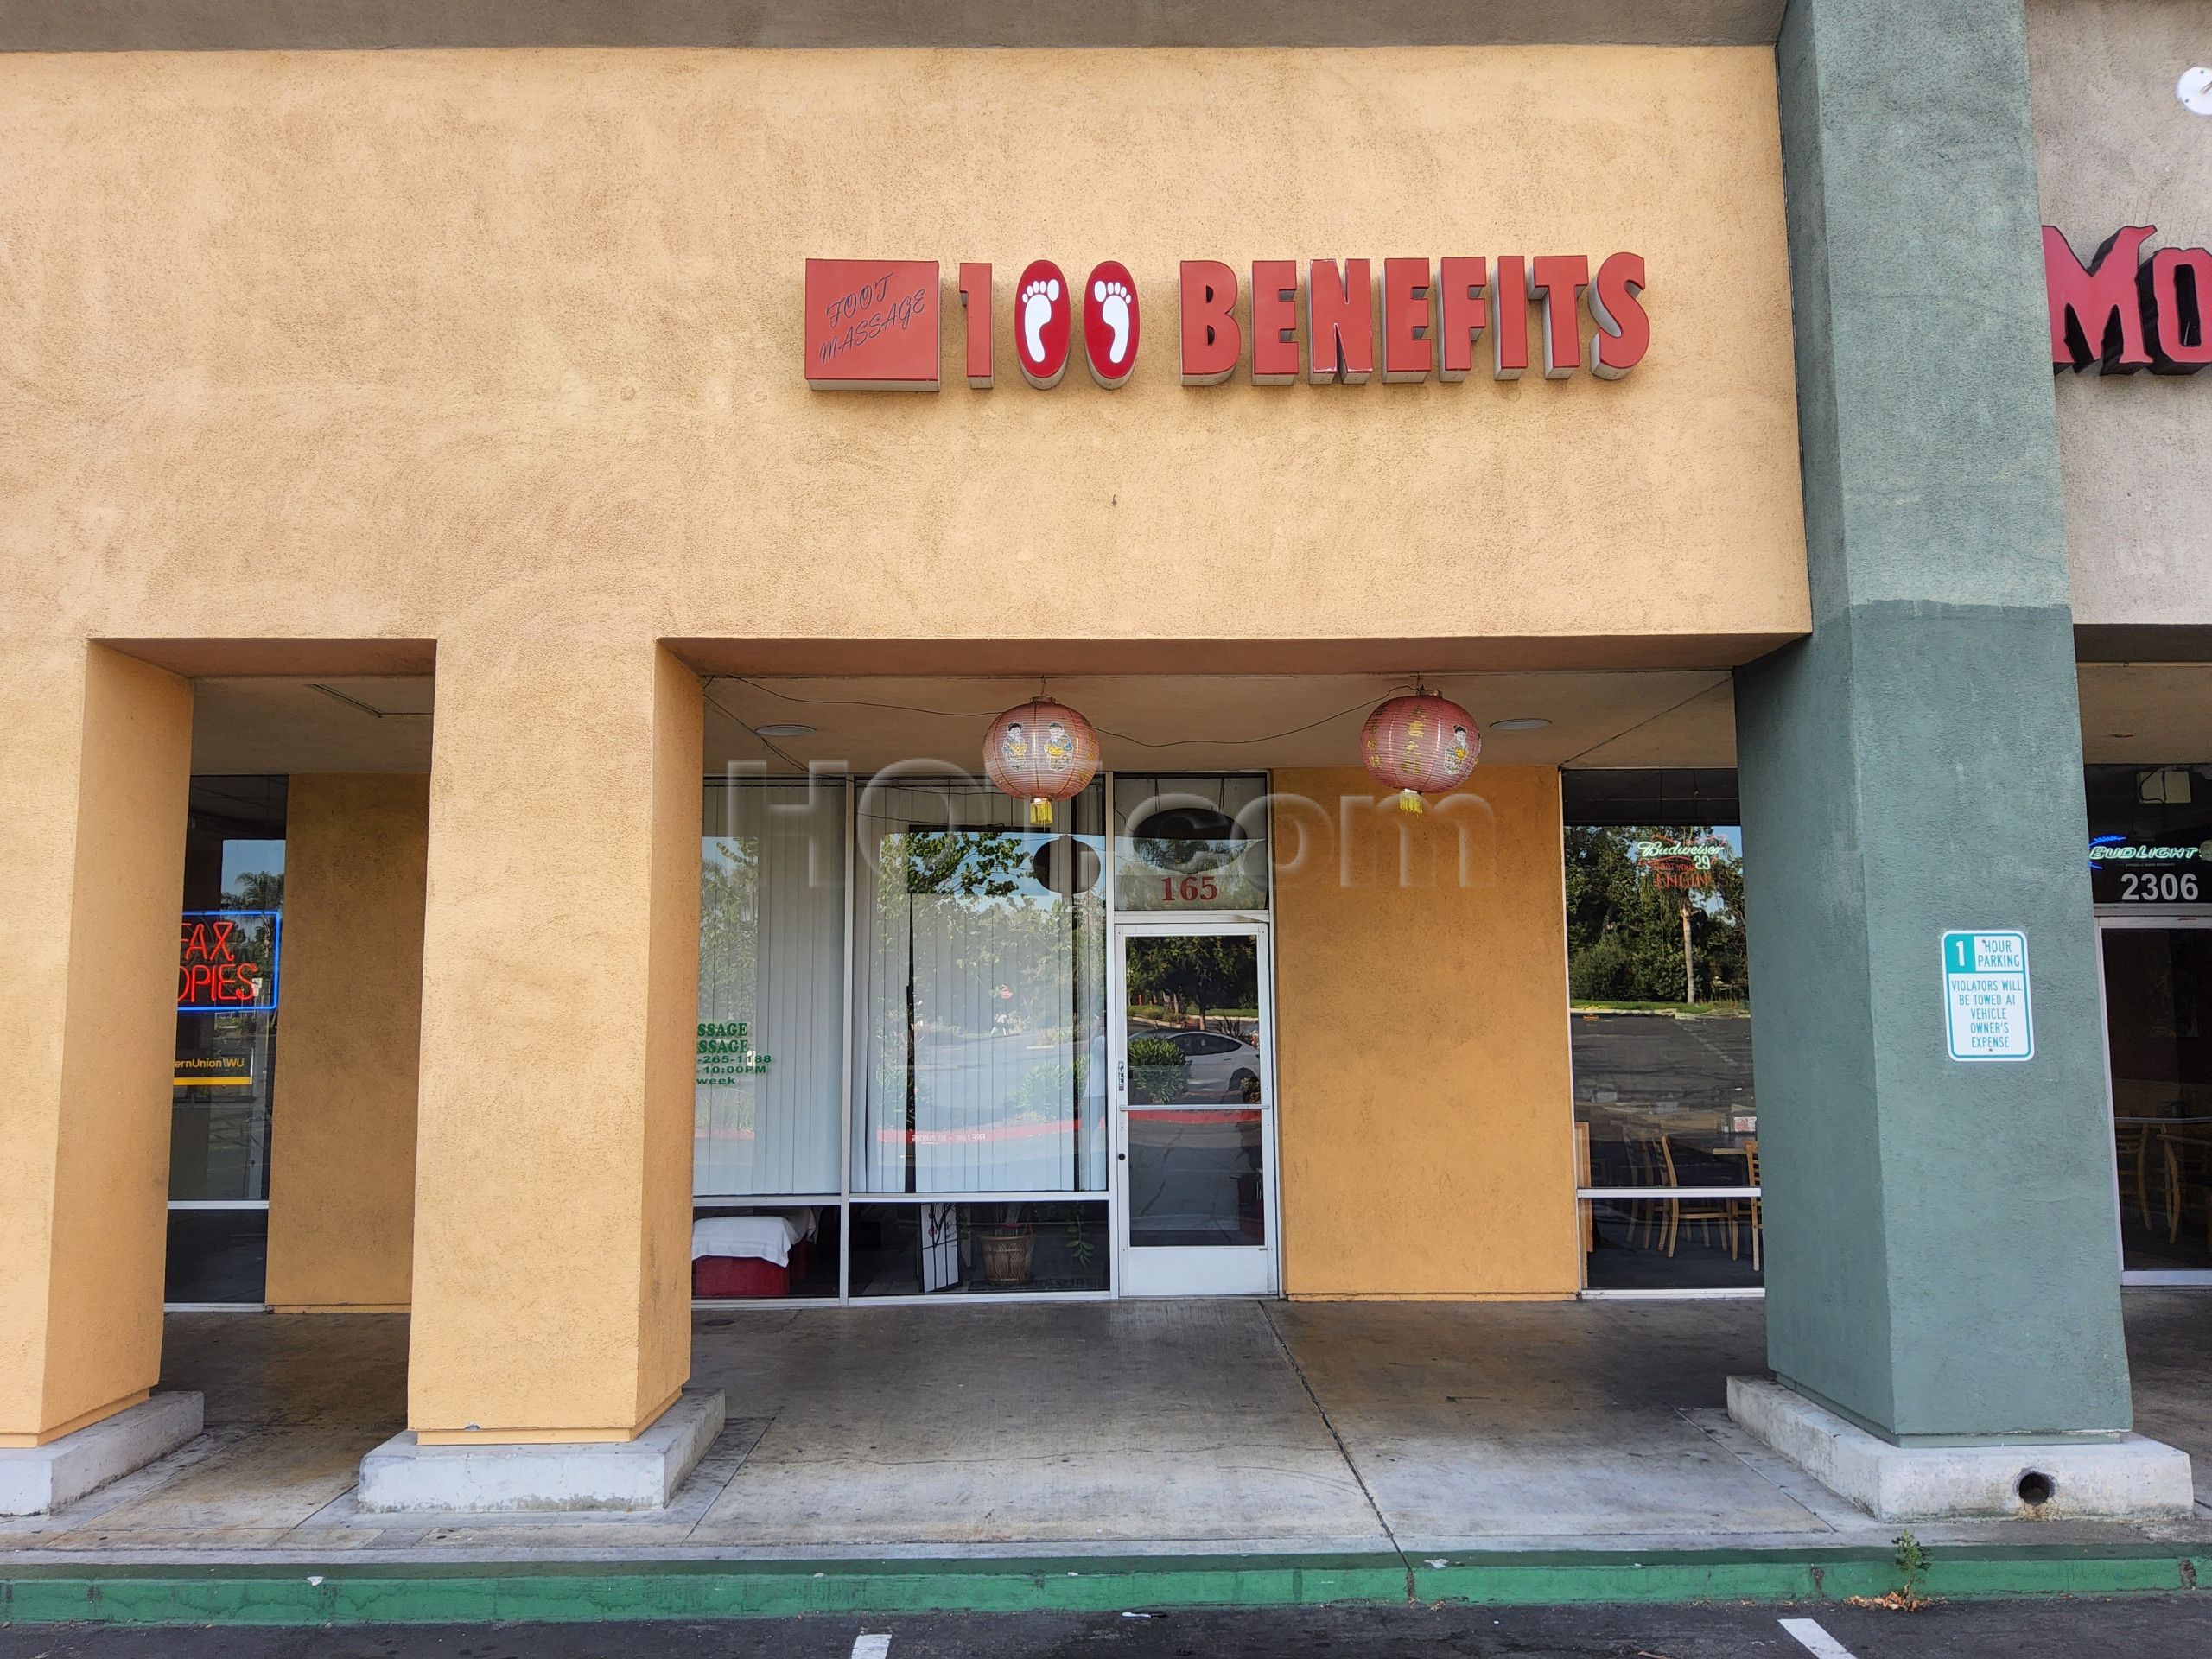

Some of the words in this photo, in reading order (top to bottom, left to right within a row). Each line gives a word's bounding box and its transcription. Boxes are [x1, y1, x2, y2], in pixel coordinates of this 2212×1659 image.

[826, 272, 894, 328] FOOT
[1180, 251, 1650, 377] BENEFITS
[819, 289, 925, 365] MASSAGE
[1637, 841, 1725, 857] Budweiser
[1694, 855, 1711, 870] 29
[1161, 876, 1217, 900] 165
[2120, 873, 2199, 900] 2306
[1985, 940, 2012, 952] HOUR
[1956, 940, 1965, 967] 1
[1978, 955, 2020, 967] PARKING
[1951, 980, 1999, 991] VIOLATORS
[2001, 980, 2023, 991] WILL
[1959, 995, 1969, 1006] BE
[1974, 994, 2001, 1005] TOWED
[2005, 994, 2016, 1005] AT
[1970, 1008, 2007, 1020] VEHICLE
[697, 1023, 747, 1037] SSAGE
[1970, 1022, 2009, 1033] OWNER'S
[697, 1039, 748, 1053] SSAGE
[1972, 1037, 2010, 1047] EXPENSE
